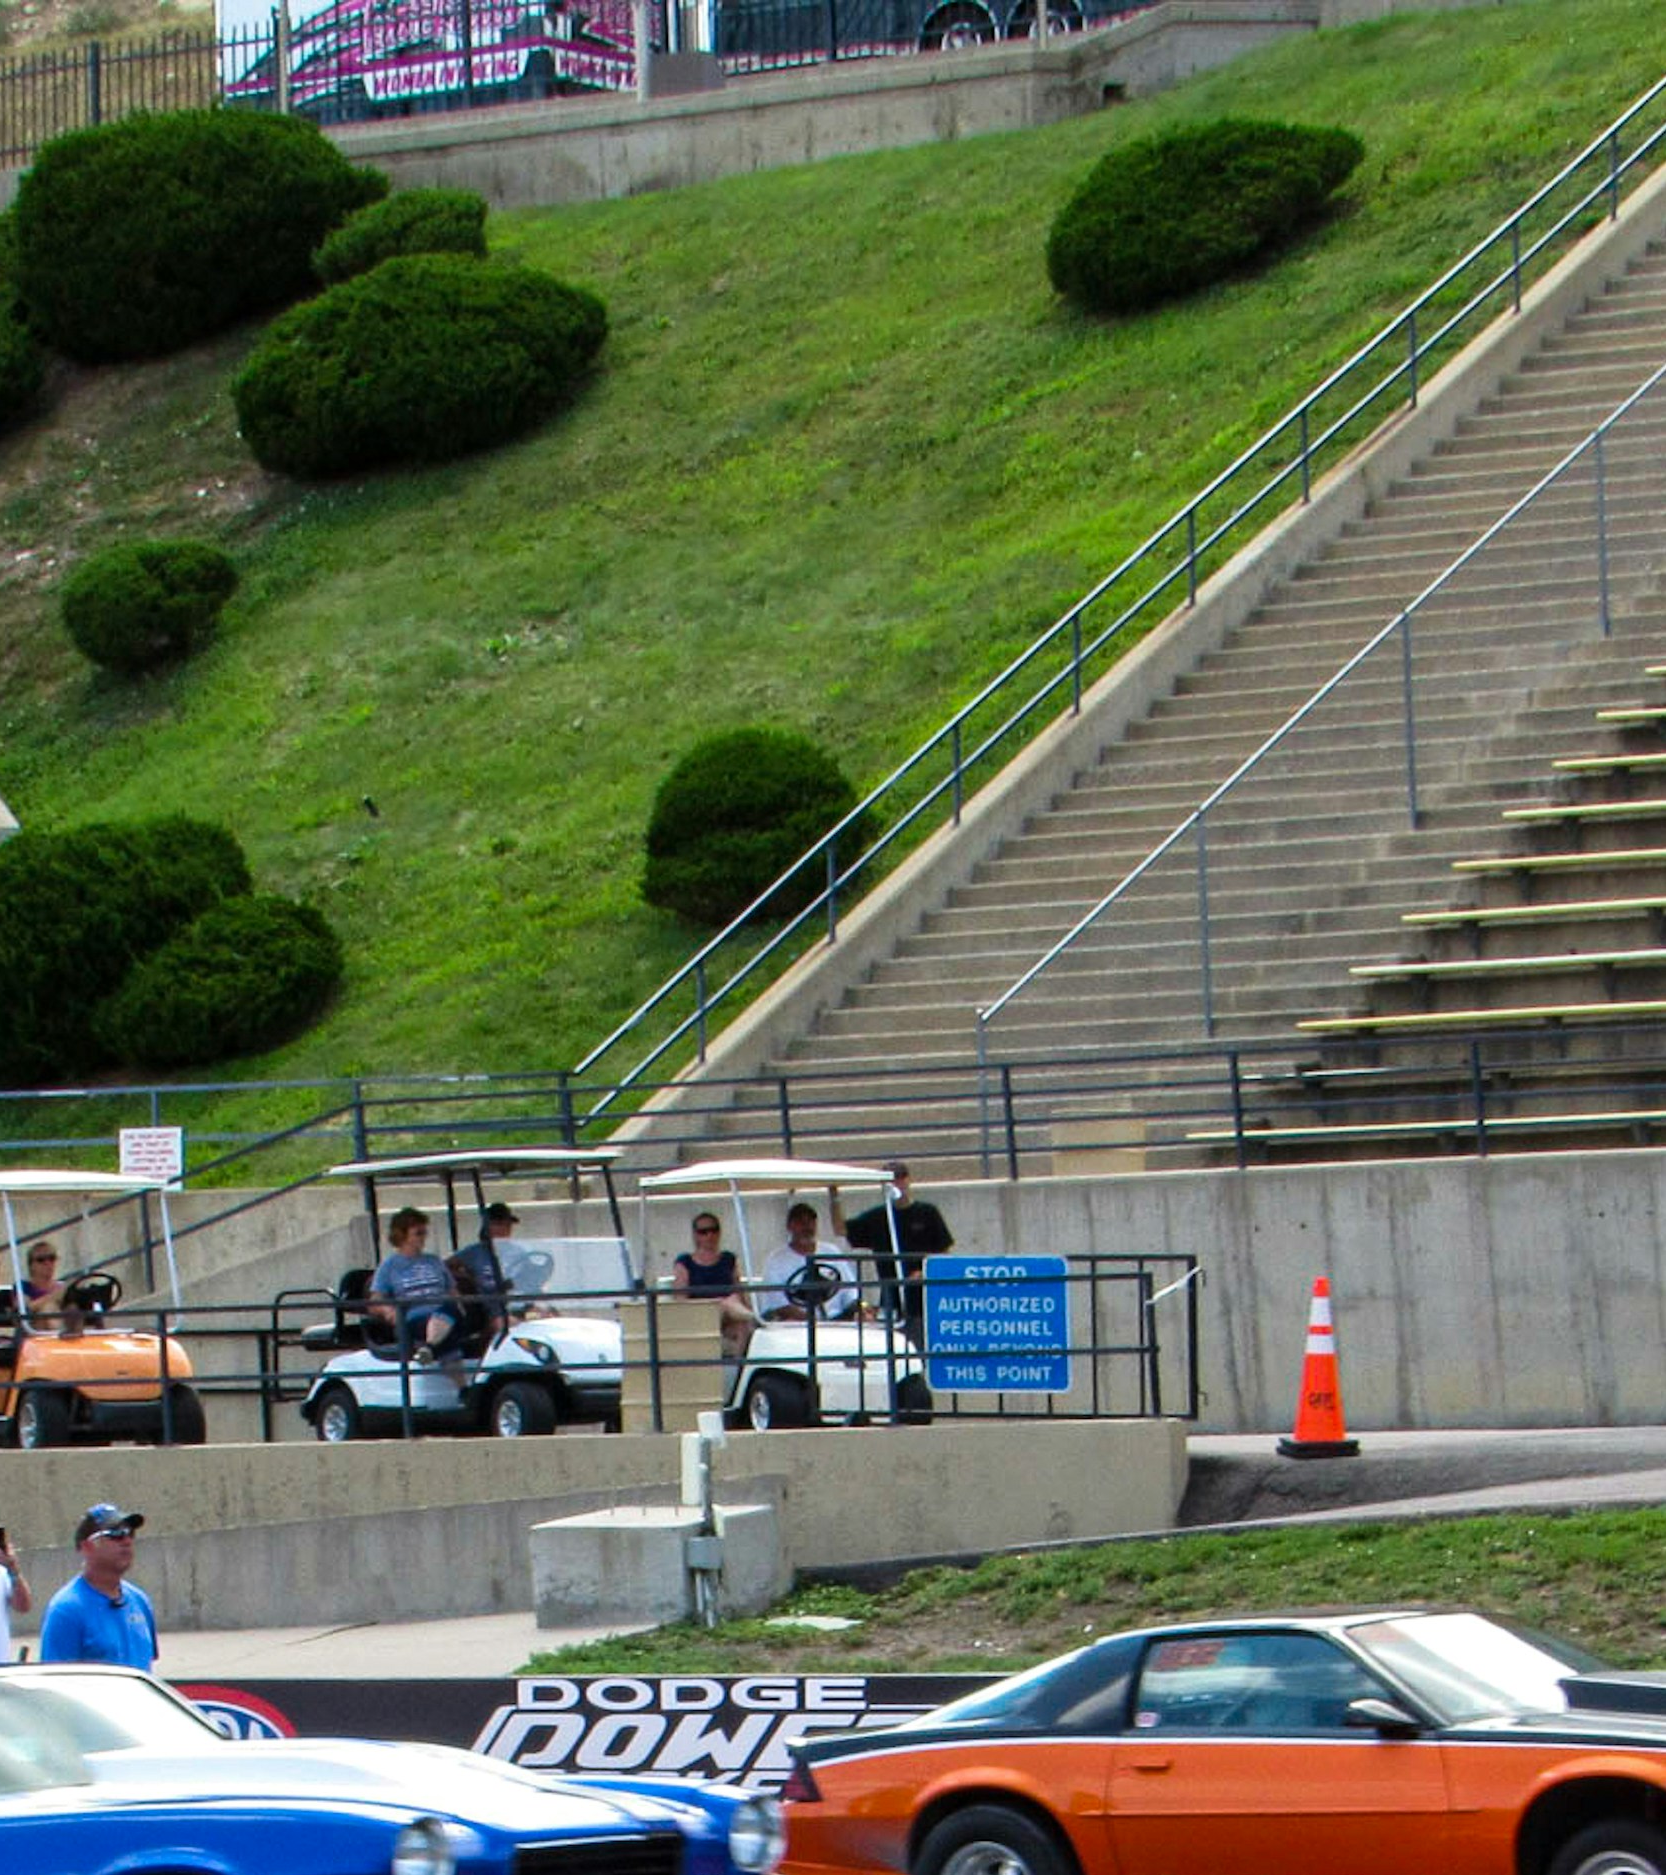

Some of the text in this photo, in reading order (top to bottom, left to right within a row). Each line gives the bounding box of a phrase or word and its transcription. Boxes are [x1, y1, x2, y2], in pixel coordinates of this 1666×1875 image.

[964, 1265, 1027, 1288] STOP
[938, 1296, 1055, 1313] AUTHORIZED
[939, 1319, 1053, 1336] PERSONNEL
[945, 1365, 1052, 1381] THIS POINT
[515, 1678, 867, 1711] DODGE
